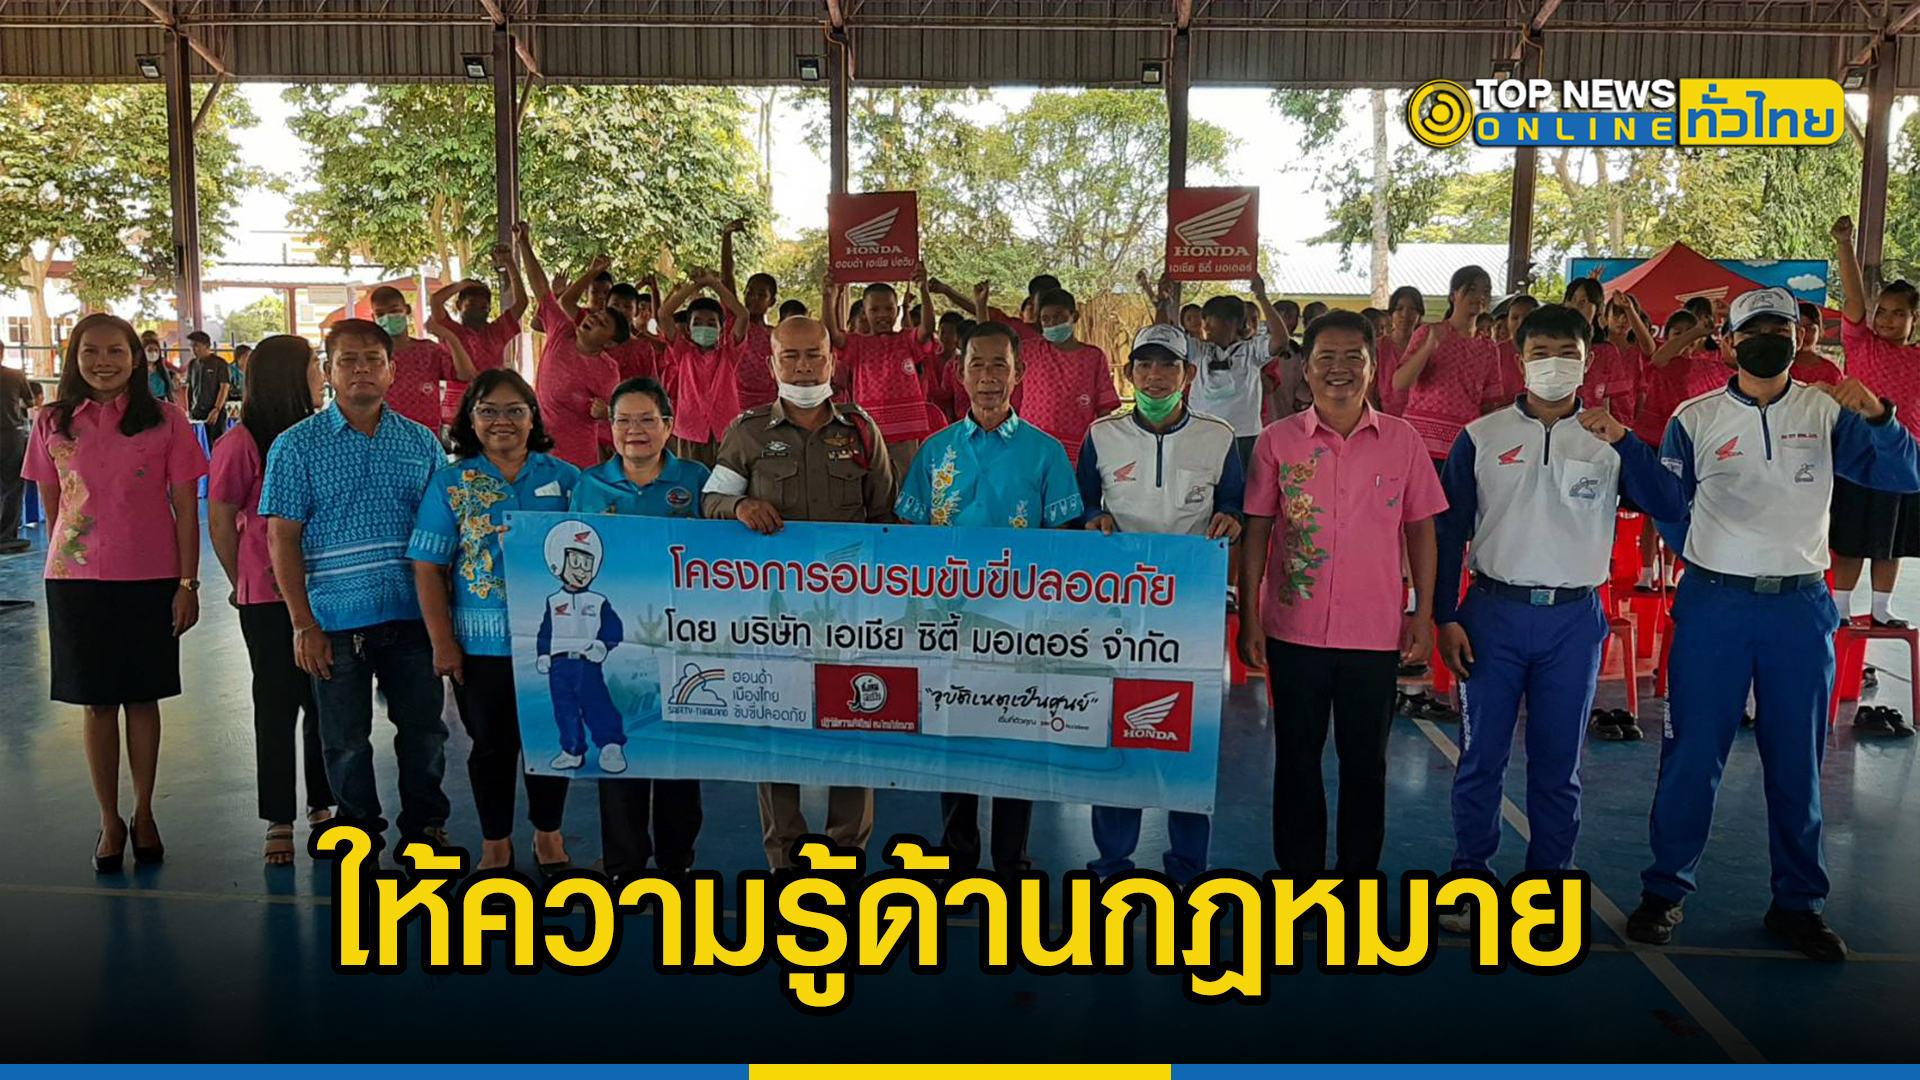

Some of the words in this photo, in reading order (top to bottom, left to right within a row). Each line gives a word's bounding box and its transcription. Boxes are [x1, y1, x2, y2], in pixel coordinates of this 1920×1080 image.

[846, 245, 903, 255] HONDA
[1173, 246, 1250, 257] HONDA
[669, 546, 1175, 606] โครงการอบรมขับขี่ปลอดภัย
[665, 608, 716, 643] โดย
[731, 615, 811, 647] บริษัท
[827, 618, 903, 650] เอเชีย
[917, 612, 961, 652] ซิตี้
[972, 628, 1090, 658] มอเตอร์
[1102, 627, 1180, 663] จำกัด
[732, 668, 773, 684] ฮอนด้า
[732, 686, 780, 703] เมืองไทย
[1123, 729, 1179, 741] HONDA
